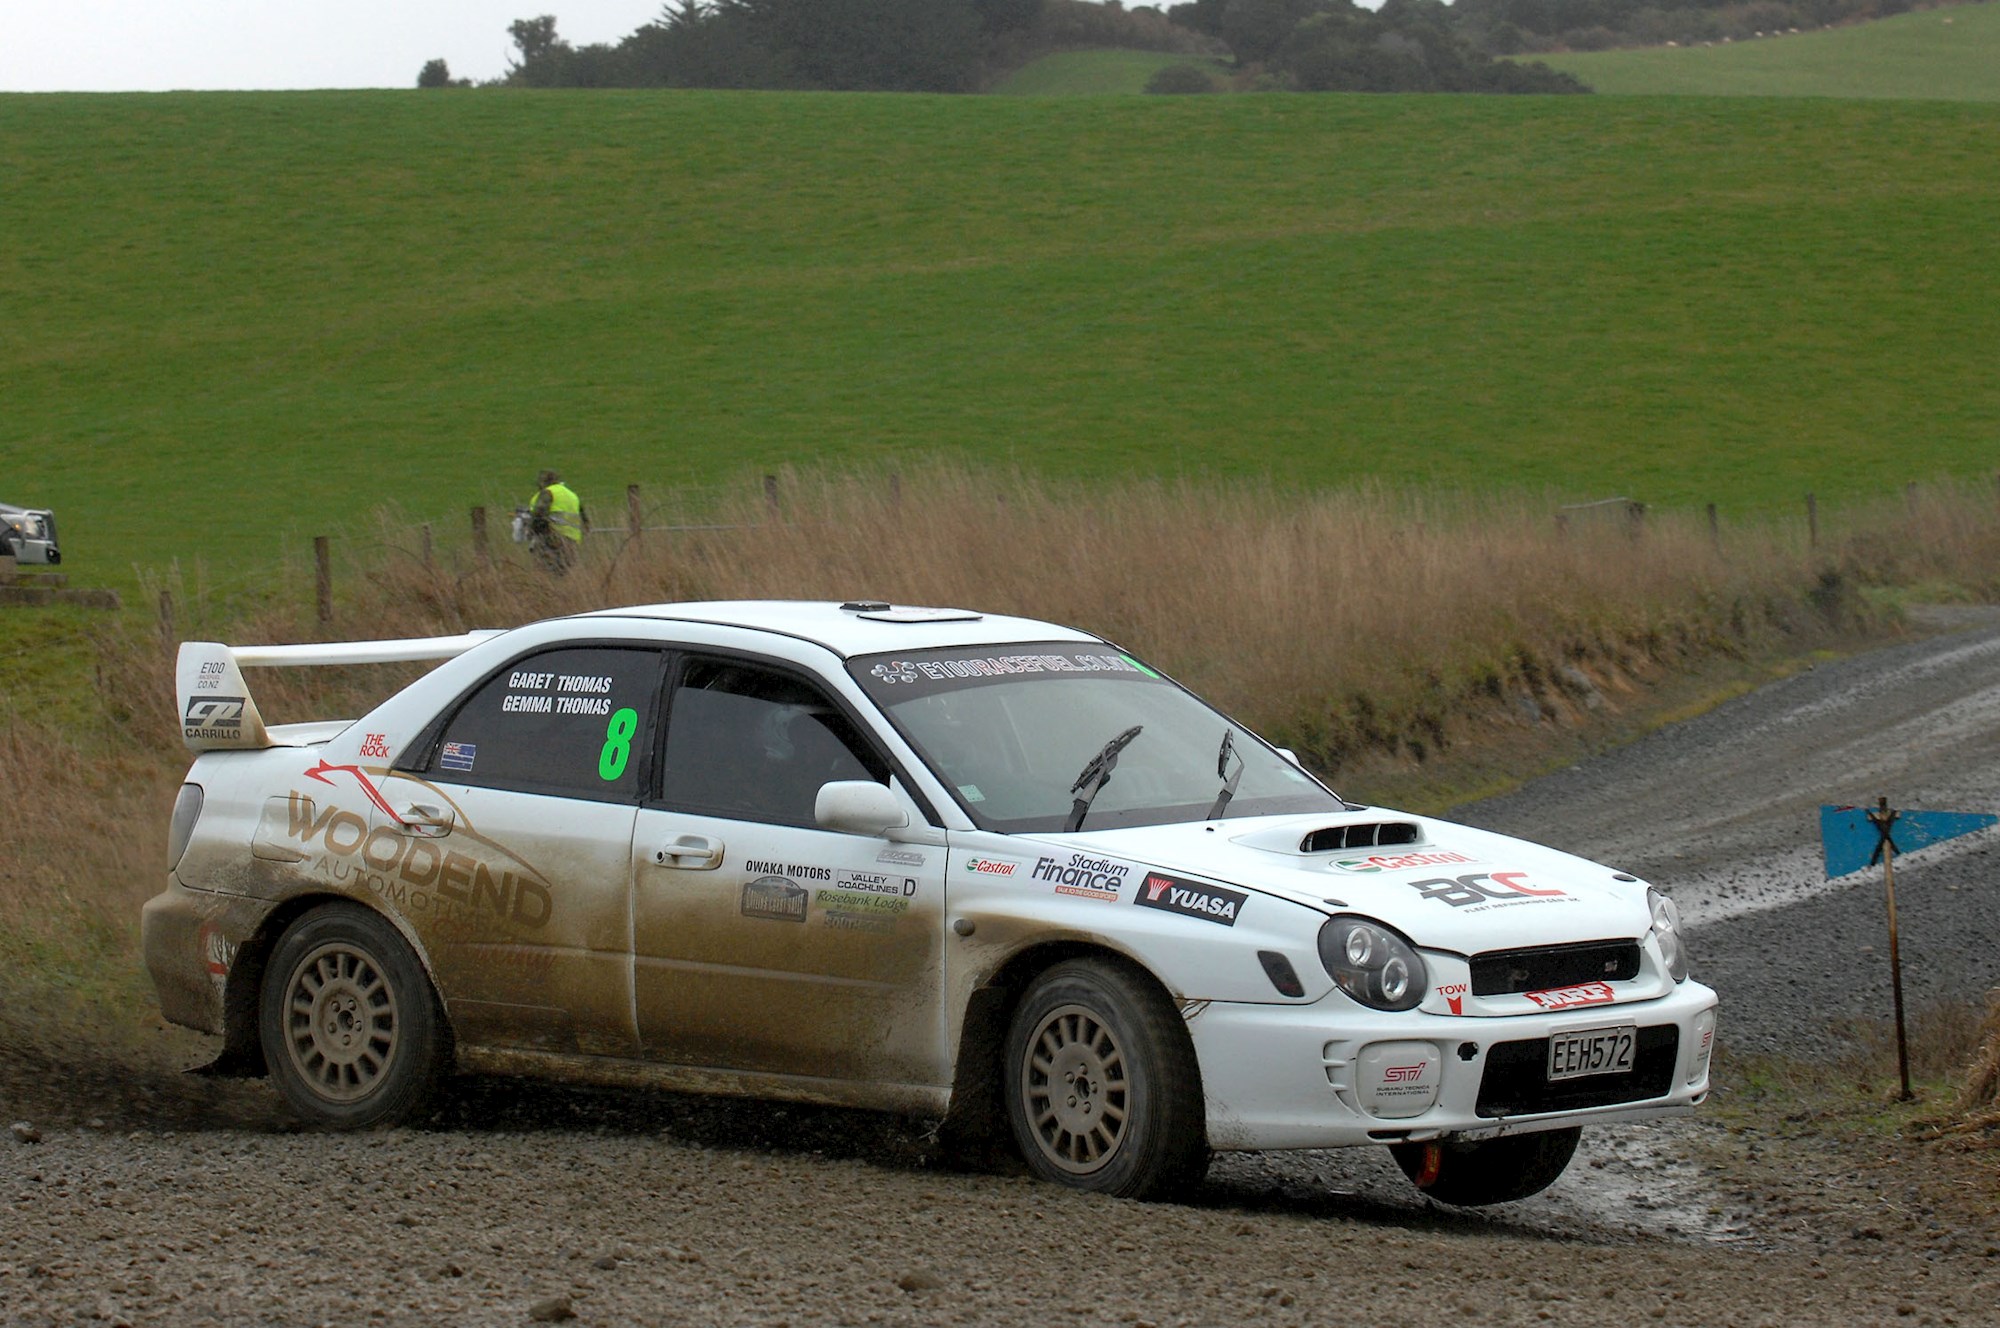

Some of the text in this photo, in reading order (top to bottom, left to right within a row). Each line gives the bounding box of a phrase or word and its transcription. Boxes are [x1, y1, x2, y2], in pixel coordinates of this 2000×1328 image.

[200, 661, 226, 674] E100
[508, 671, 613, 694] GARET THOMAS
[502, 695, 611, 716] GEMMA THOMAS
[185, 728, 241, 740] CARRILLO
[365, 733, 386, 746] THE
[598, 707, 638, 781] 8
[359, 745, 391, 758] ROCK
[288, 789, 553, 929] WOODEND
[976, 858, 1017, 876] Castrol
[1068, 853, 1130, 878] Stadium
[1366, 851, 1479, 871] Castrol
[746, 860, 831, 881] OWAKA MOTORS
[851, 873, 888, 884] VALLEY
[1032, 856, 1123, 892] Finance
[837, 880, 899, 895] COACHLINES
[903, 878, 916, 897] D
[1407, 872, 1567, 907] BCC
[817, 890, 872, 906] Rosebank
[874, 896, 909, 913] Lodge
[1168, 887, 1235, 919] YUASA
[1436, 983, 1467, 995] TOW
[1551, 1034, 1633, 1075] EEH572
